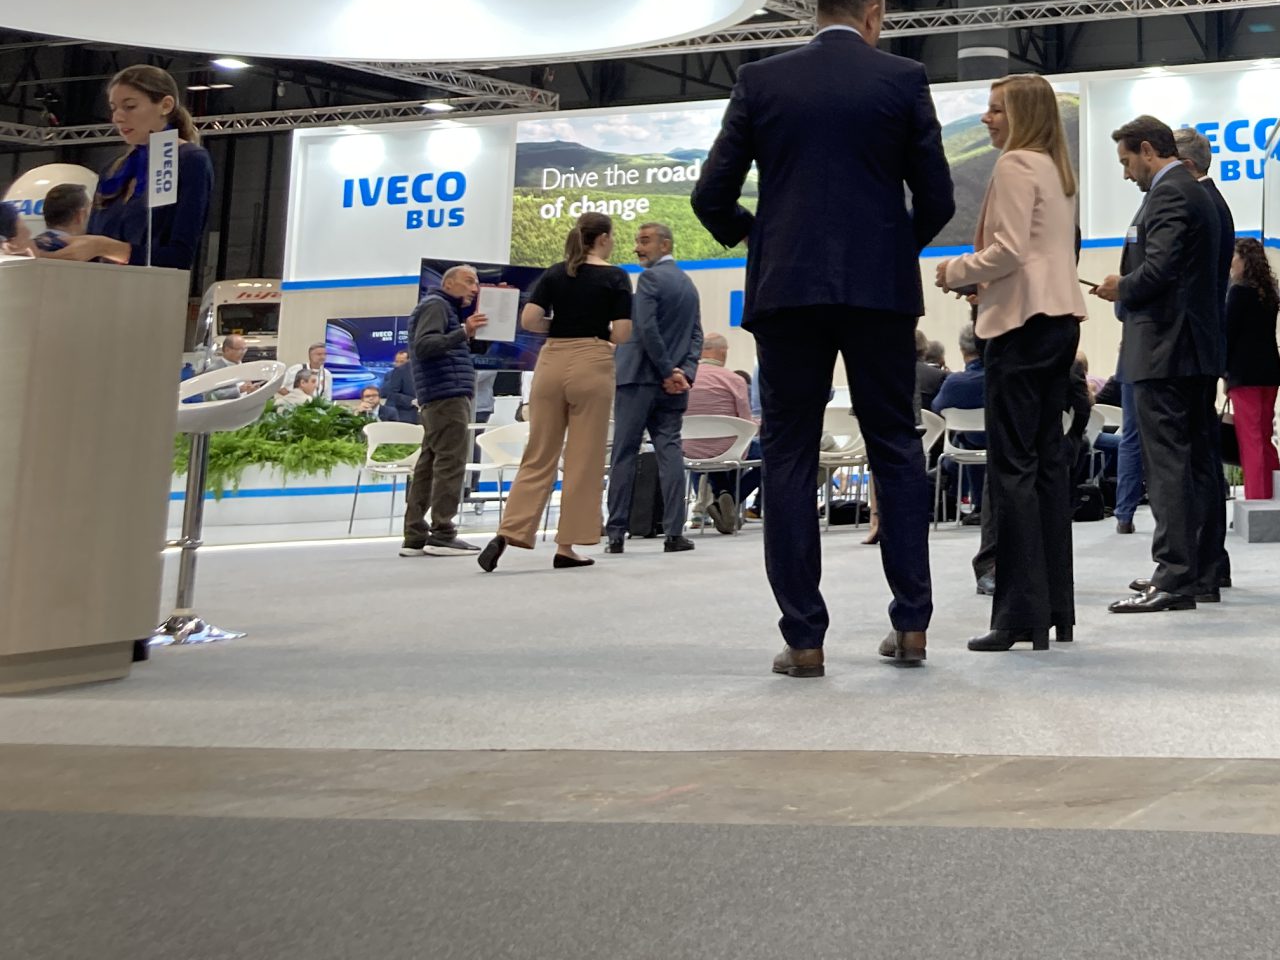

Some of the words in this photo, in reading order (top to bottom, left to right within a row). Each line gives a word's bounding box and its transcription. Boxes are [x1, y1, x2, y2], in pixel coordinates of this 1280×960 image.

[163, 141, 173, 192] IVECO
[542, 166, 599, 190] Drive
[603, 163, 640, 187] the
[646, 158, 701, 184] road
[1220, 159, 1265, 181] BU
[343, 171, 467, 208] IVECO
[406, 207, 465, 230] BUS
[540, 196, 566, 219] of
[569, 195, 650, 221] change
